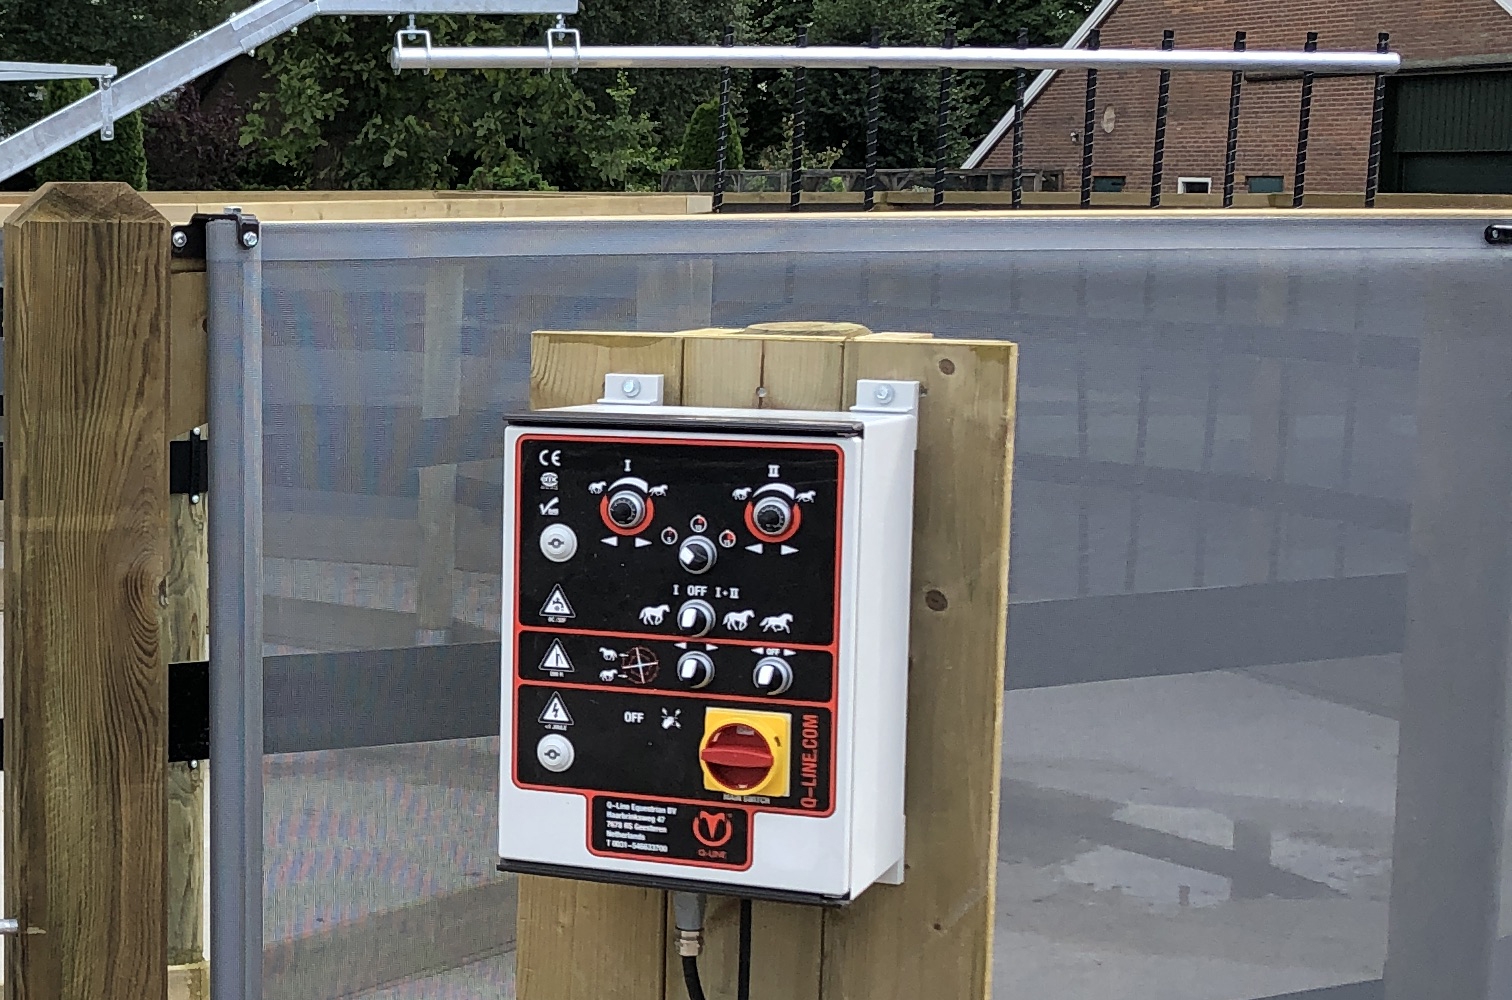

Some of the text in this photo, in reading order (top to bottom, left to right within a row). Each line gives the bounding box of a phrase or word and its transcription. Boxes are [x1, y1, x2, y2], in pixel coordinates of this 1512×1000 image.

[768, 464, 780, 478] II
[687, 584, 708, 597] OFF
[623, 711, 644, 724] OFF
[800, 714, 819, 809] Q-LINE.COM
